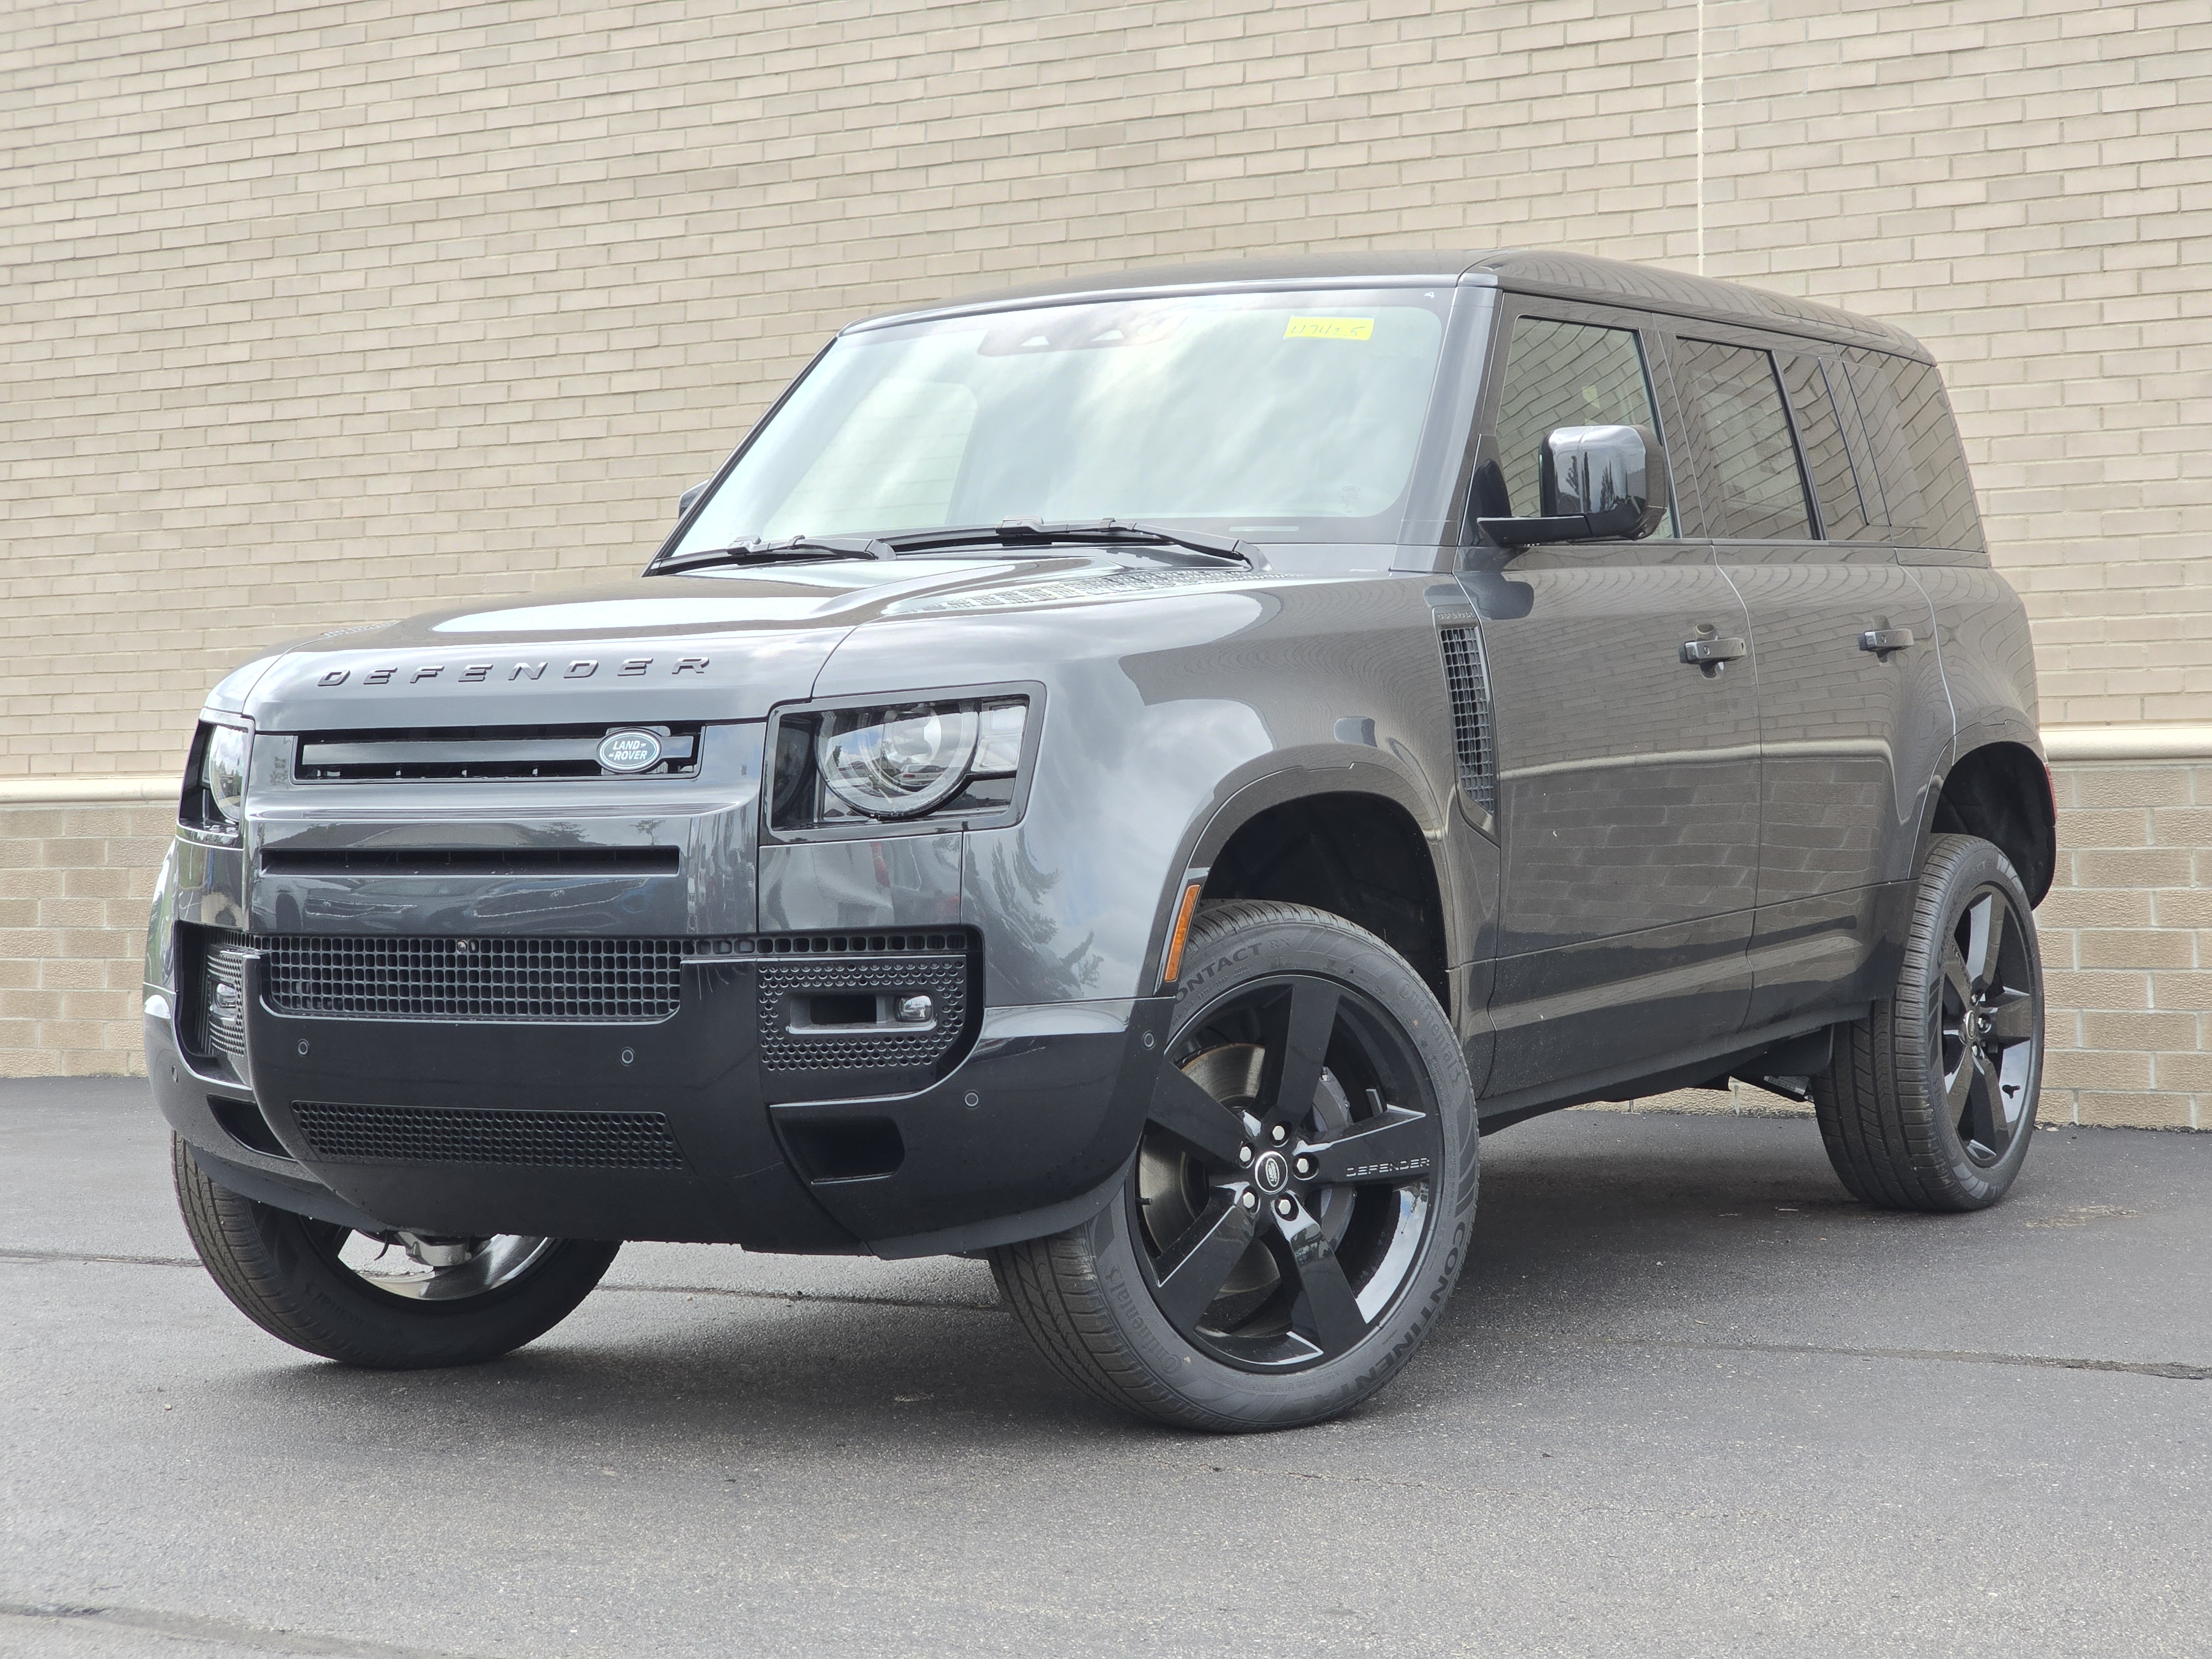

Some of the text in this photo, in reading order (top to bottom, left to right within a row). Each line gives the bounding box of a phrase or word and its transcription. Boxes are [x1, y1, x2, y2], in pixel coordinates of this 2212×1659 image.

[1290, 324, 1366, 337] 47425
[317, 656, 711, 687] DEFENDER
[612, 740, 640, 750] LAND
[613, 750, 648, 760] ROVER
[1346, 1157, 1430, 1177] DEFENDER
